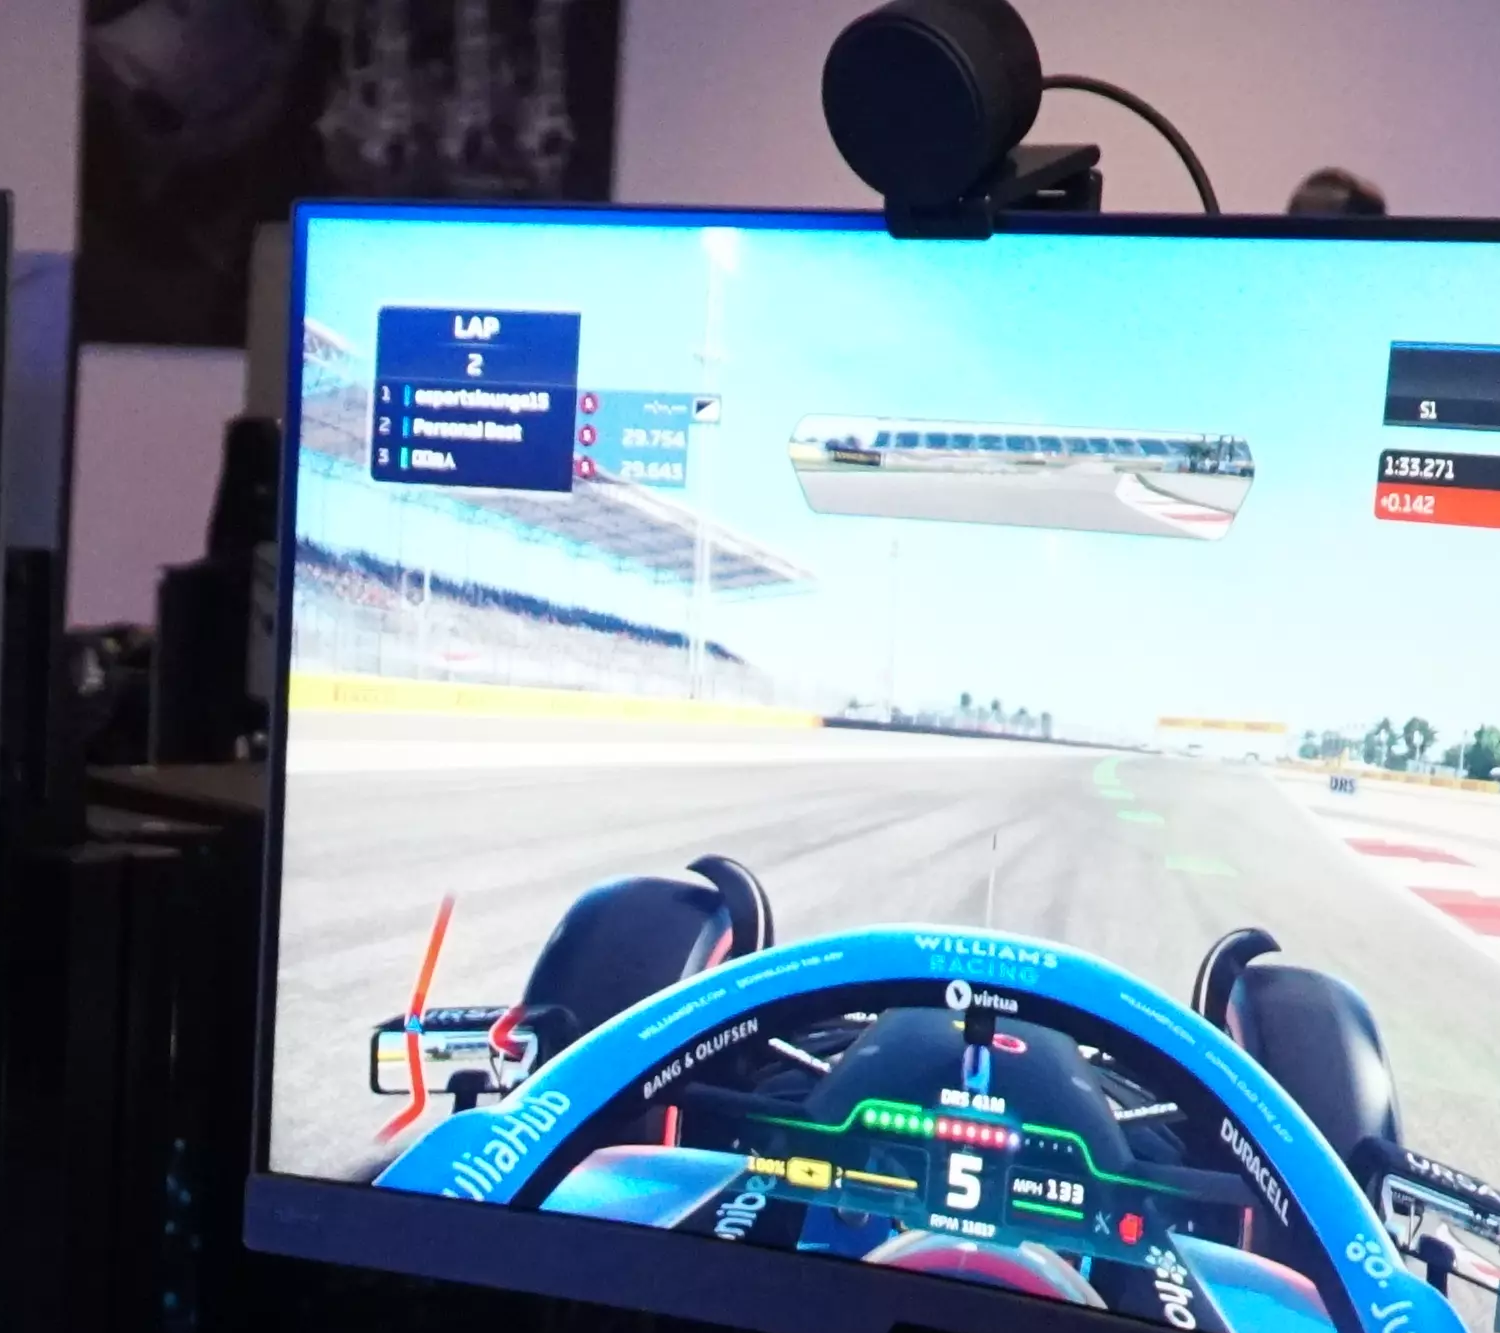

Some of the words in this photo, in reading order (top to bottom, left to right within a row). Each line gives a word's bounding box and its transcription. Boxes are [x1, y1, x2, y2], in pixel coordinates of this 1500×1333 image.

[455, 316, 499, 339] LAP
[467, 353, 483, 376] 2
[382, 386, 390, 401] 1
[1420, 401, 1437, 419] S1
[379, 417, 391, 431] 2
[413, 418, 483, 439] Personal
[378, 449, 389, 463] 3
[1384, 456, 1455, 480] 1:33.271
[1380, 495, 1435, 515] +0.142
[914, 934, 1058, 969] WILLIAMS
[643, 1061, 682, 1100] BANG
[684, 1053, 694, 1069] &
[695, 1017, 759, 1061] OLUFSEN
[946, 1152, 983, 1210] 5
[1220, 1117, 1289, 1227] DURACELL
[1013, 1178, 1042, 1196] MPH
[1046, 1178, 1084, 1205] 133
